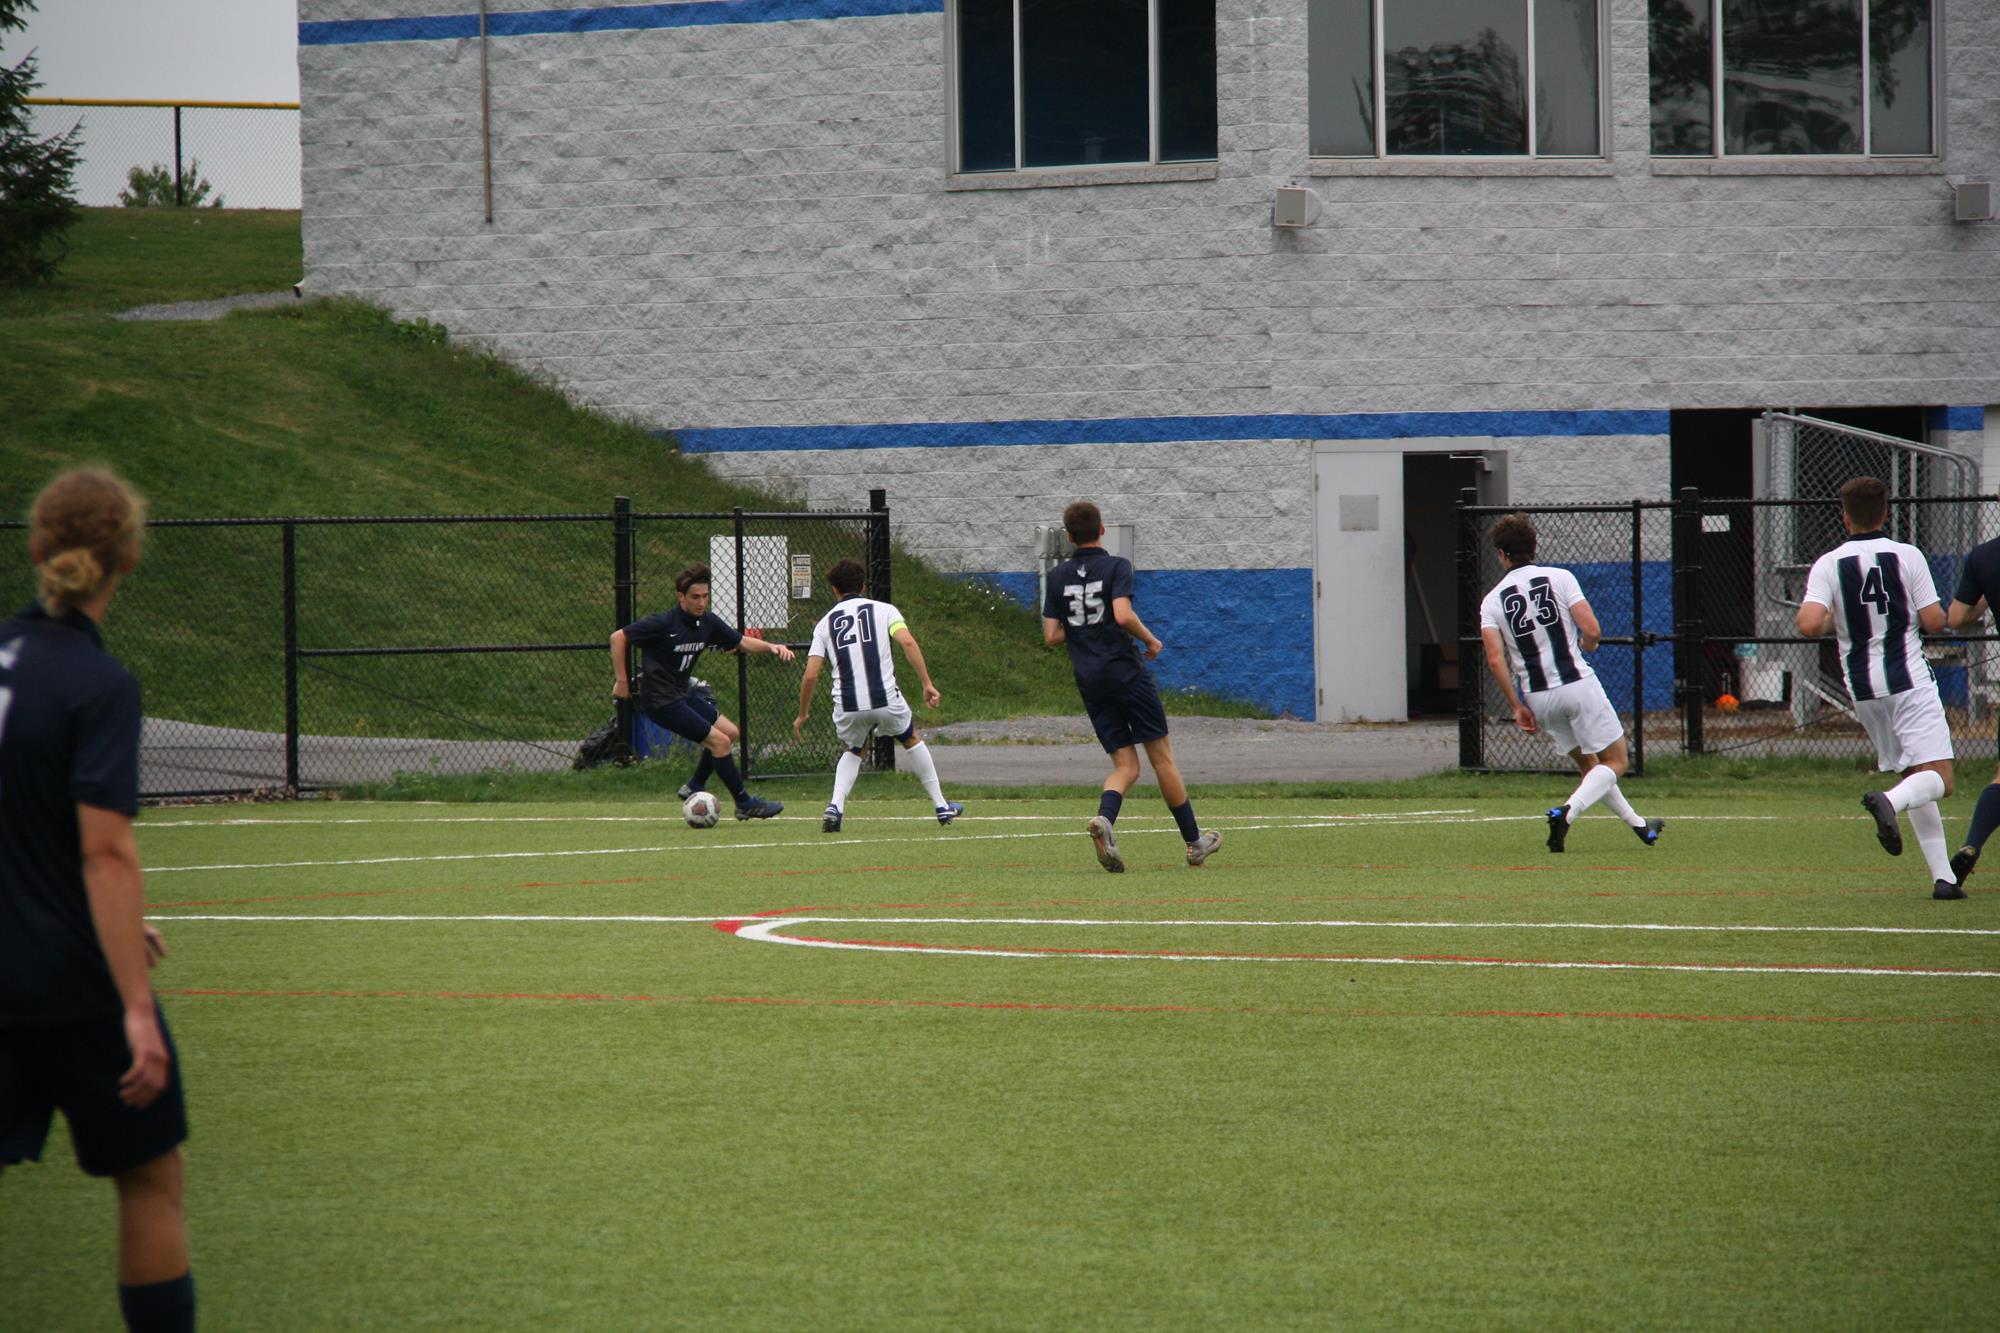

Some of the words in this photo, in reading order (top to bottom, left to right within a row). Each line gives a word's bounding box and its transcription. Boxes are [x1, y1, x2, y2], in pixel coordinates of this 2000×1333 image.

[1063, 580, 1105, 627] 35
[1504, 583, 1559, 638] 23
[1860, 565, 1889, 615] 4
[833, 608, 872, 649] 21
